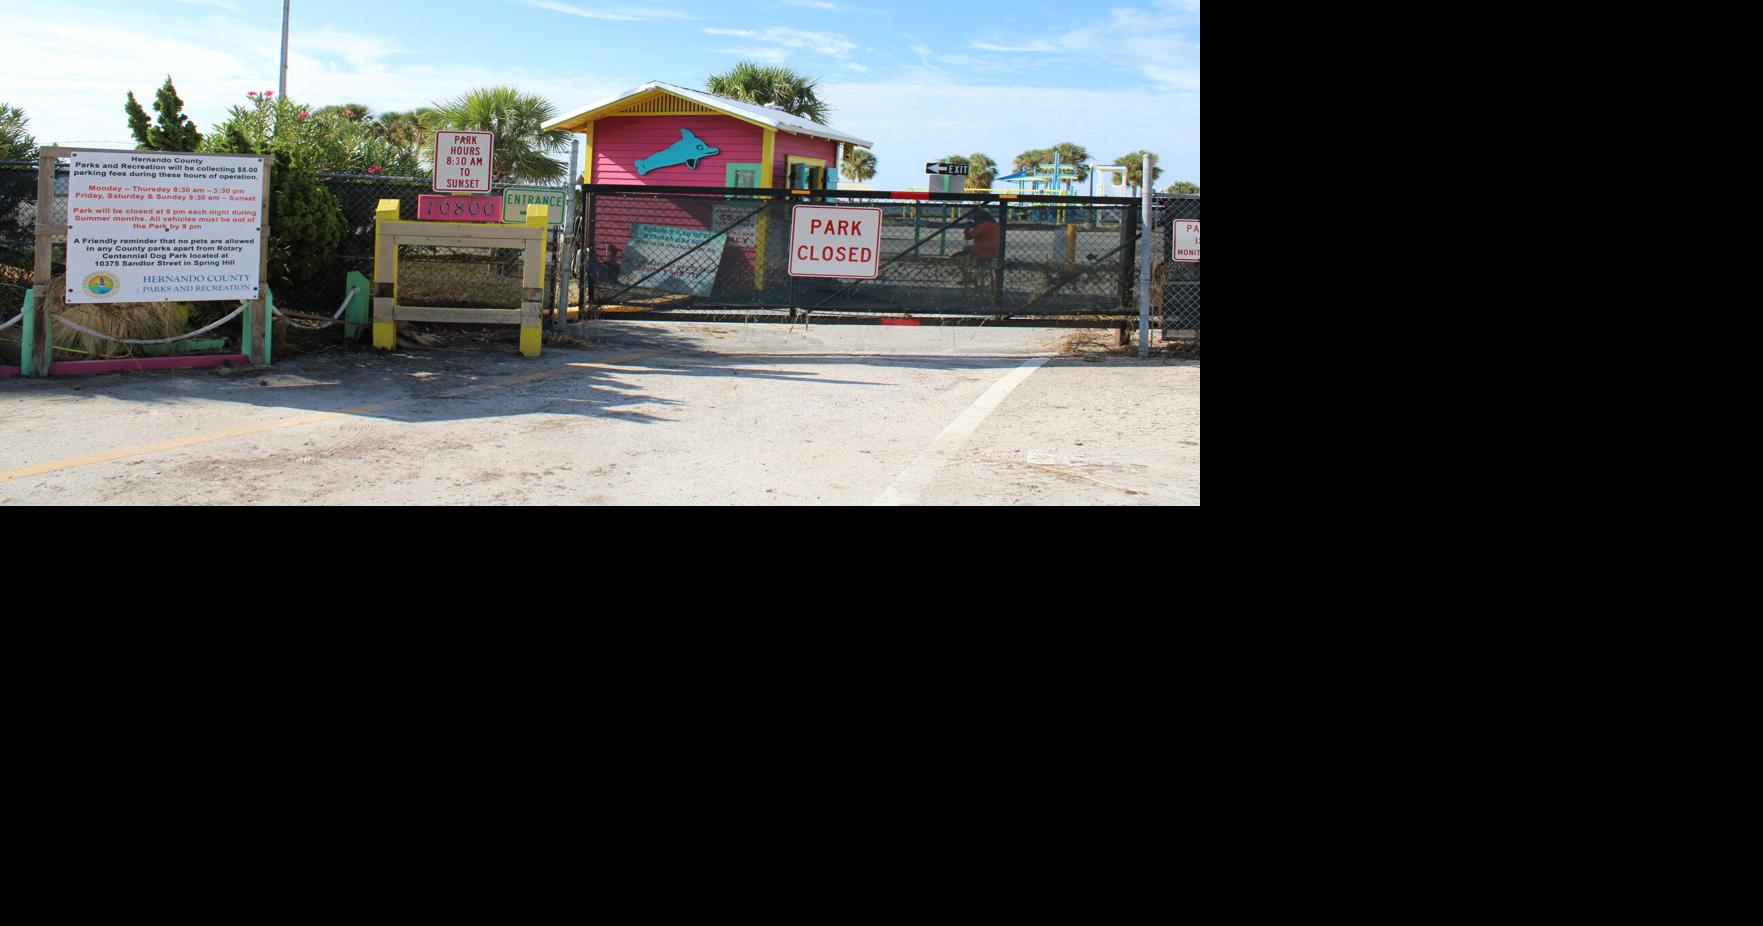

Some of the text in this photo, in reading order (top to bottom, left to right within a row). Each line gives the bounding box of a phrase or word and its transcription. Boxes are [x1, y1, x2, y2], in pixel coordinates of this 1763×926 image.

[454, 136, 477, 144] PARK
[450, 146, 480, 156] HOURS
[446, 157, 482, 165] 8:30 AM
[949, 164, 968, 174] EXIT
[446, 179, 480, 188] SUNSET
[508, 194, 562, 207] ENTRANCE
[426, 201, 495, 217] 10800
[810, 219, 862, 236] PARK
[797, 246, 872, 263] CLOSED
[143, 274, 251, 283] HERNANDO COUNTY
